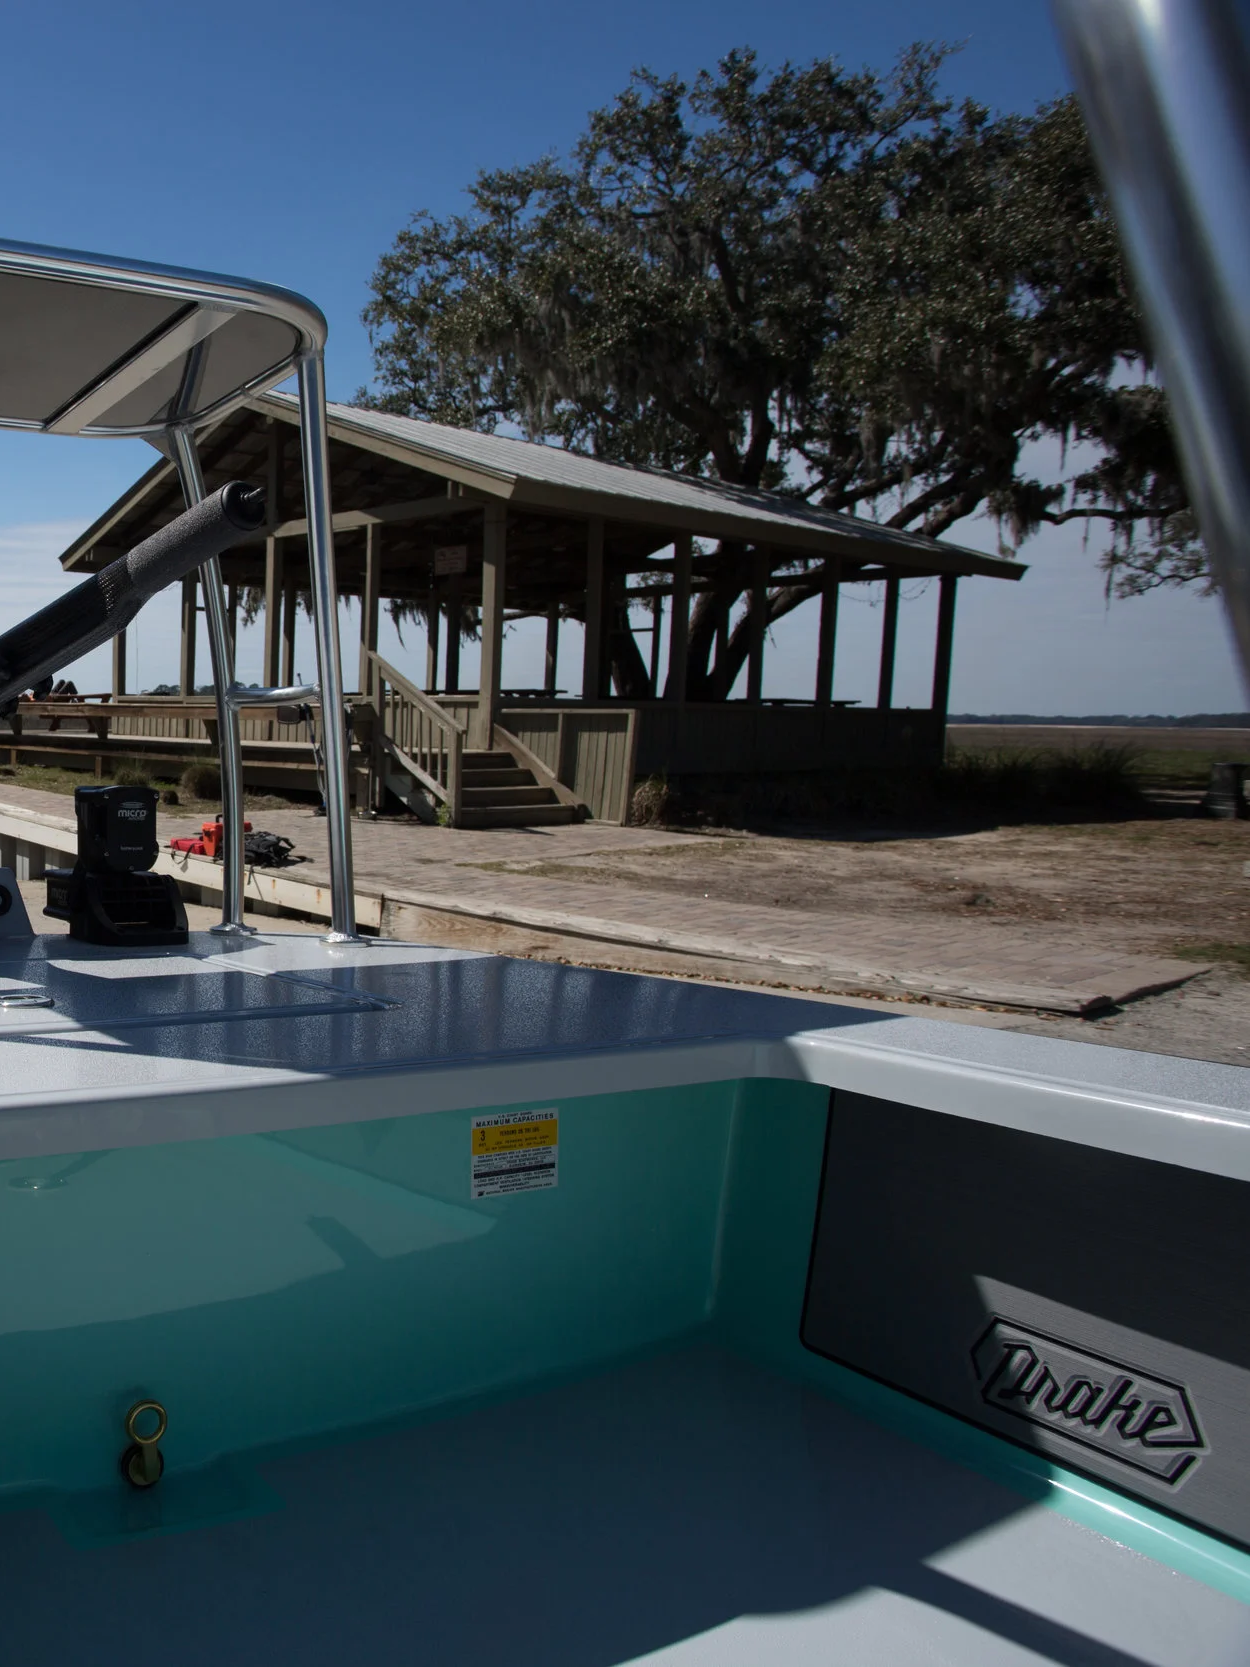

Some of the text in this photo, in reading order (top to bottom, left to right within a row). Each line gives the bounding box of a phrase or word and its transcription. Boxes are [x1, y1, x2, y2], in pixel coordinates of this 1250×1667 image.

[117, 809, 147, 817] micro
[476, 1112, 554, 1128] MAXIMUM CAPACITIES
[480, 1130, 486, 1142] 3
[982, 1339, 1195, 1448] Drake
